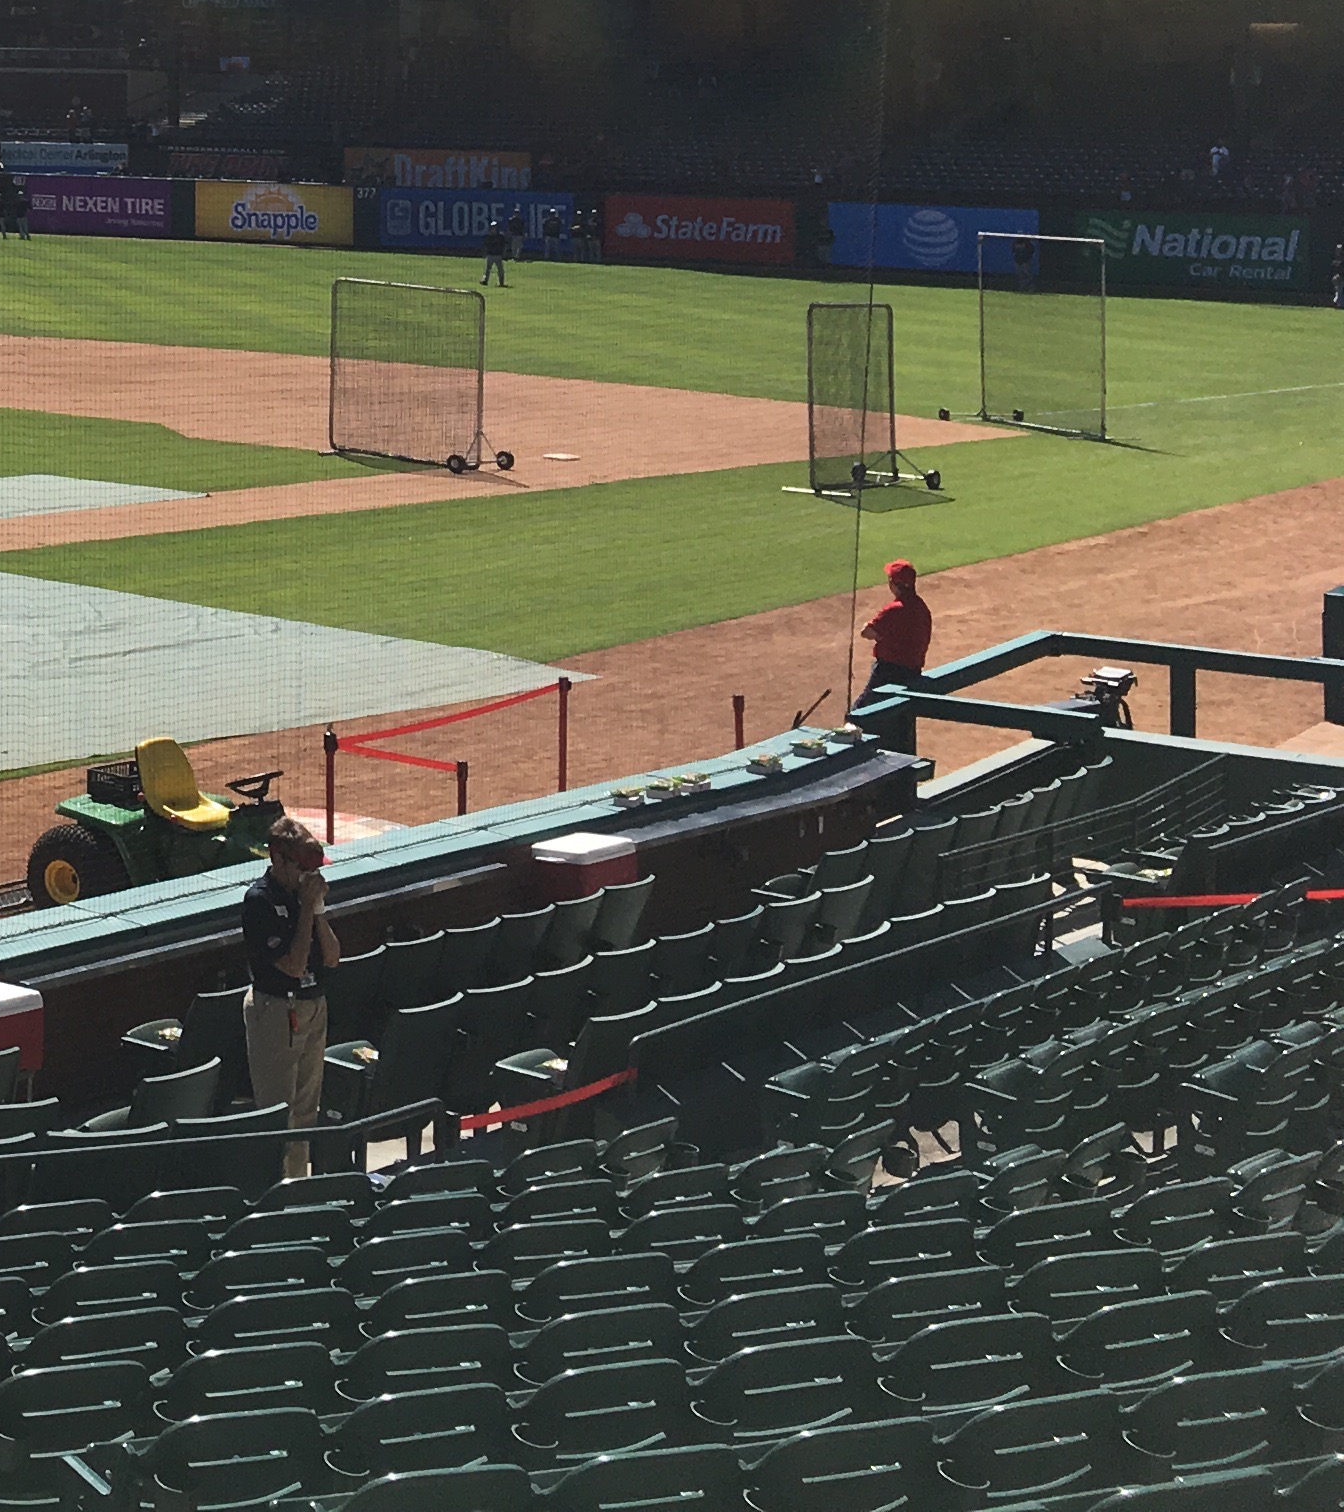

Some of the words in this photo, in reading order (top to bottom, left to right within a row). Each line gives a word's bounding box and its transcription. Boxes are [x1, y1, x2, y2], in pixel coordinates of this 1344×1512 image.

[74, 148, 127, 164] Arlington
[356, 188, 378, 199] 377
[62, 195, 120, 214] NEXEN
[123, 197, 165, 216] TIRE
[228, 203, 320, 240] Snapple
[418, 199, 505, 237] GLOBE
[1130, 223, 1300, 262] National
[1189, 262, 1221, 278] Car
[1228, 264, 1292, 281] Rental
